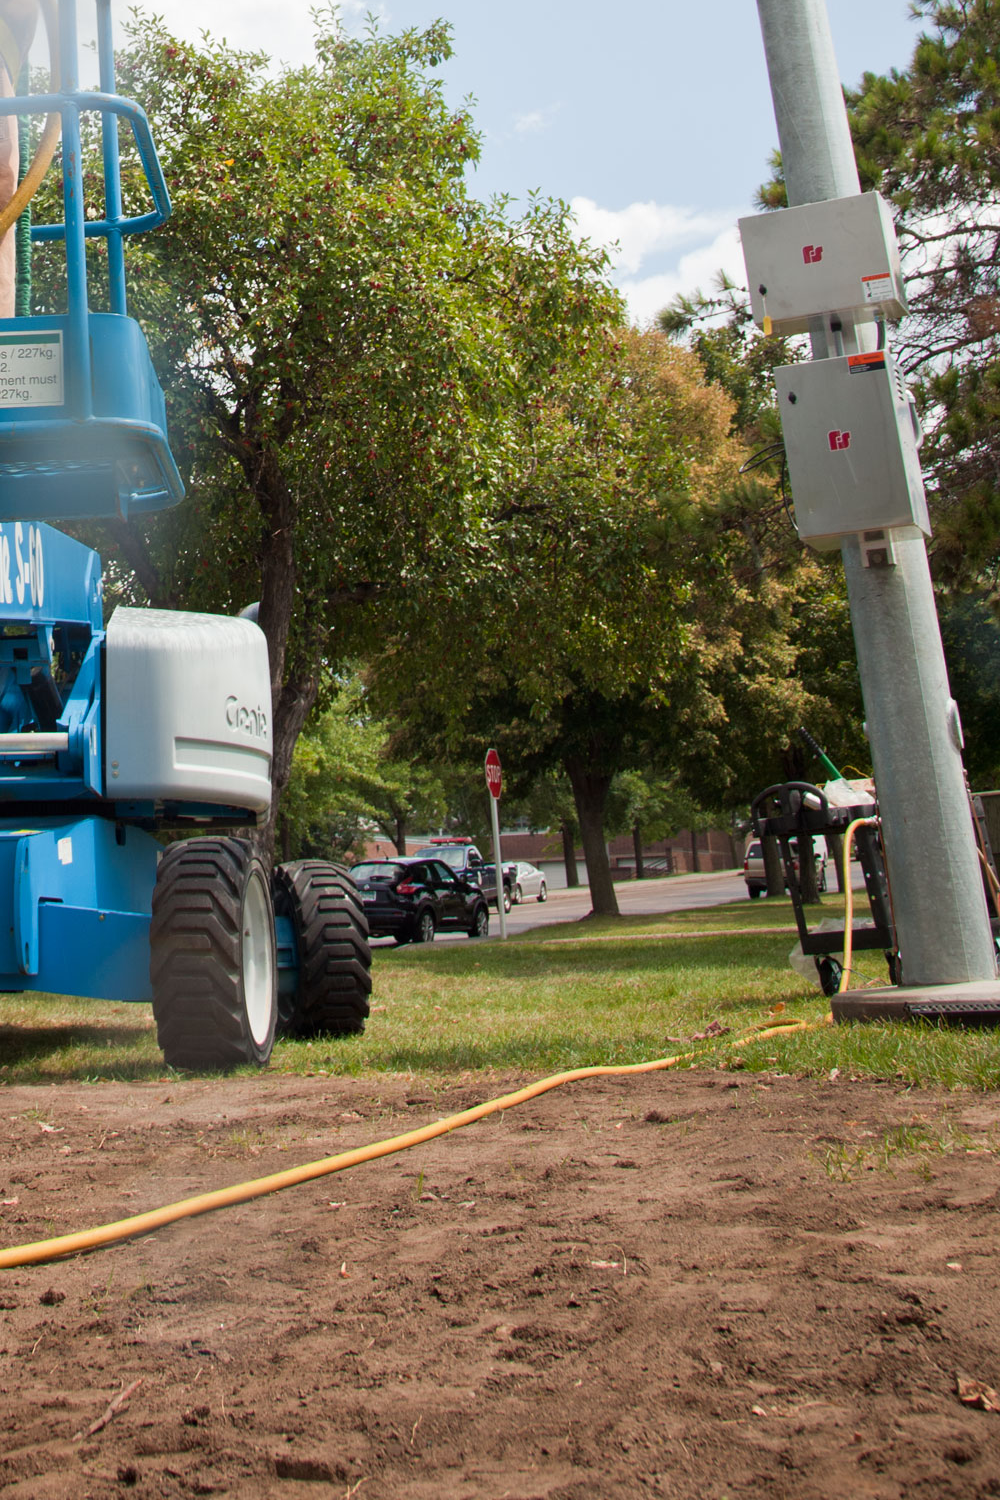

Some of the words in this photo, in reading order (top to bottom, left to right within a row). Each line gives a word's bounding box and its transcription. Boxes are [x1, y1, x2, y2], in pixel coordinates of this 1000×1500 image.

[10, 348, 15, 359] /
[18, 348, 57, 360] 227kg.
[0, 362, 11, 373] 2.
[29, 374, 57, 385] must
[14, 521, 44, 608] S-60
[224, 693, 268, 740] Genie
[486, 764, 501, 784] STOP
